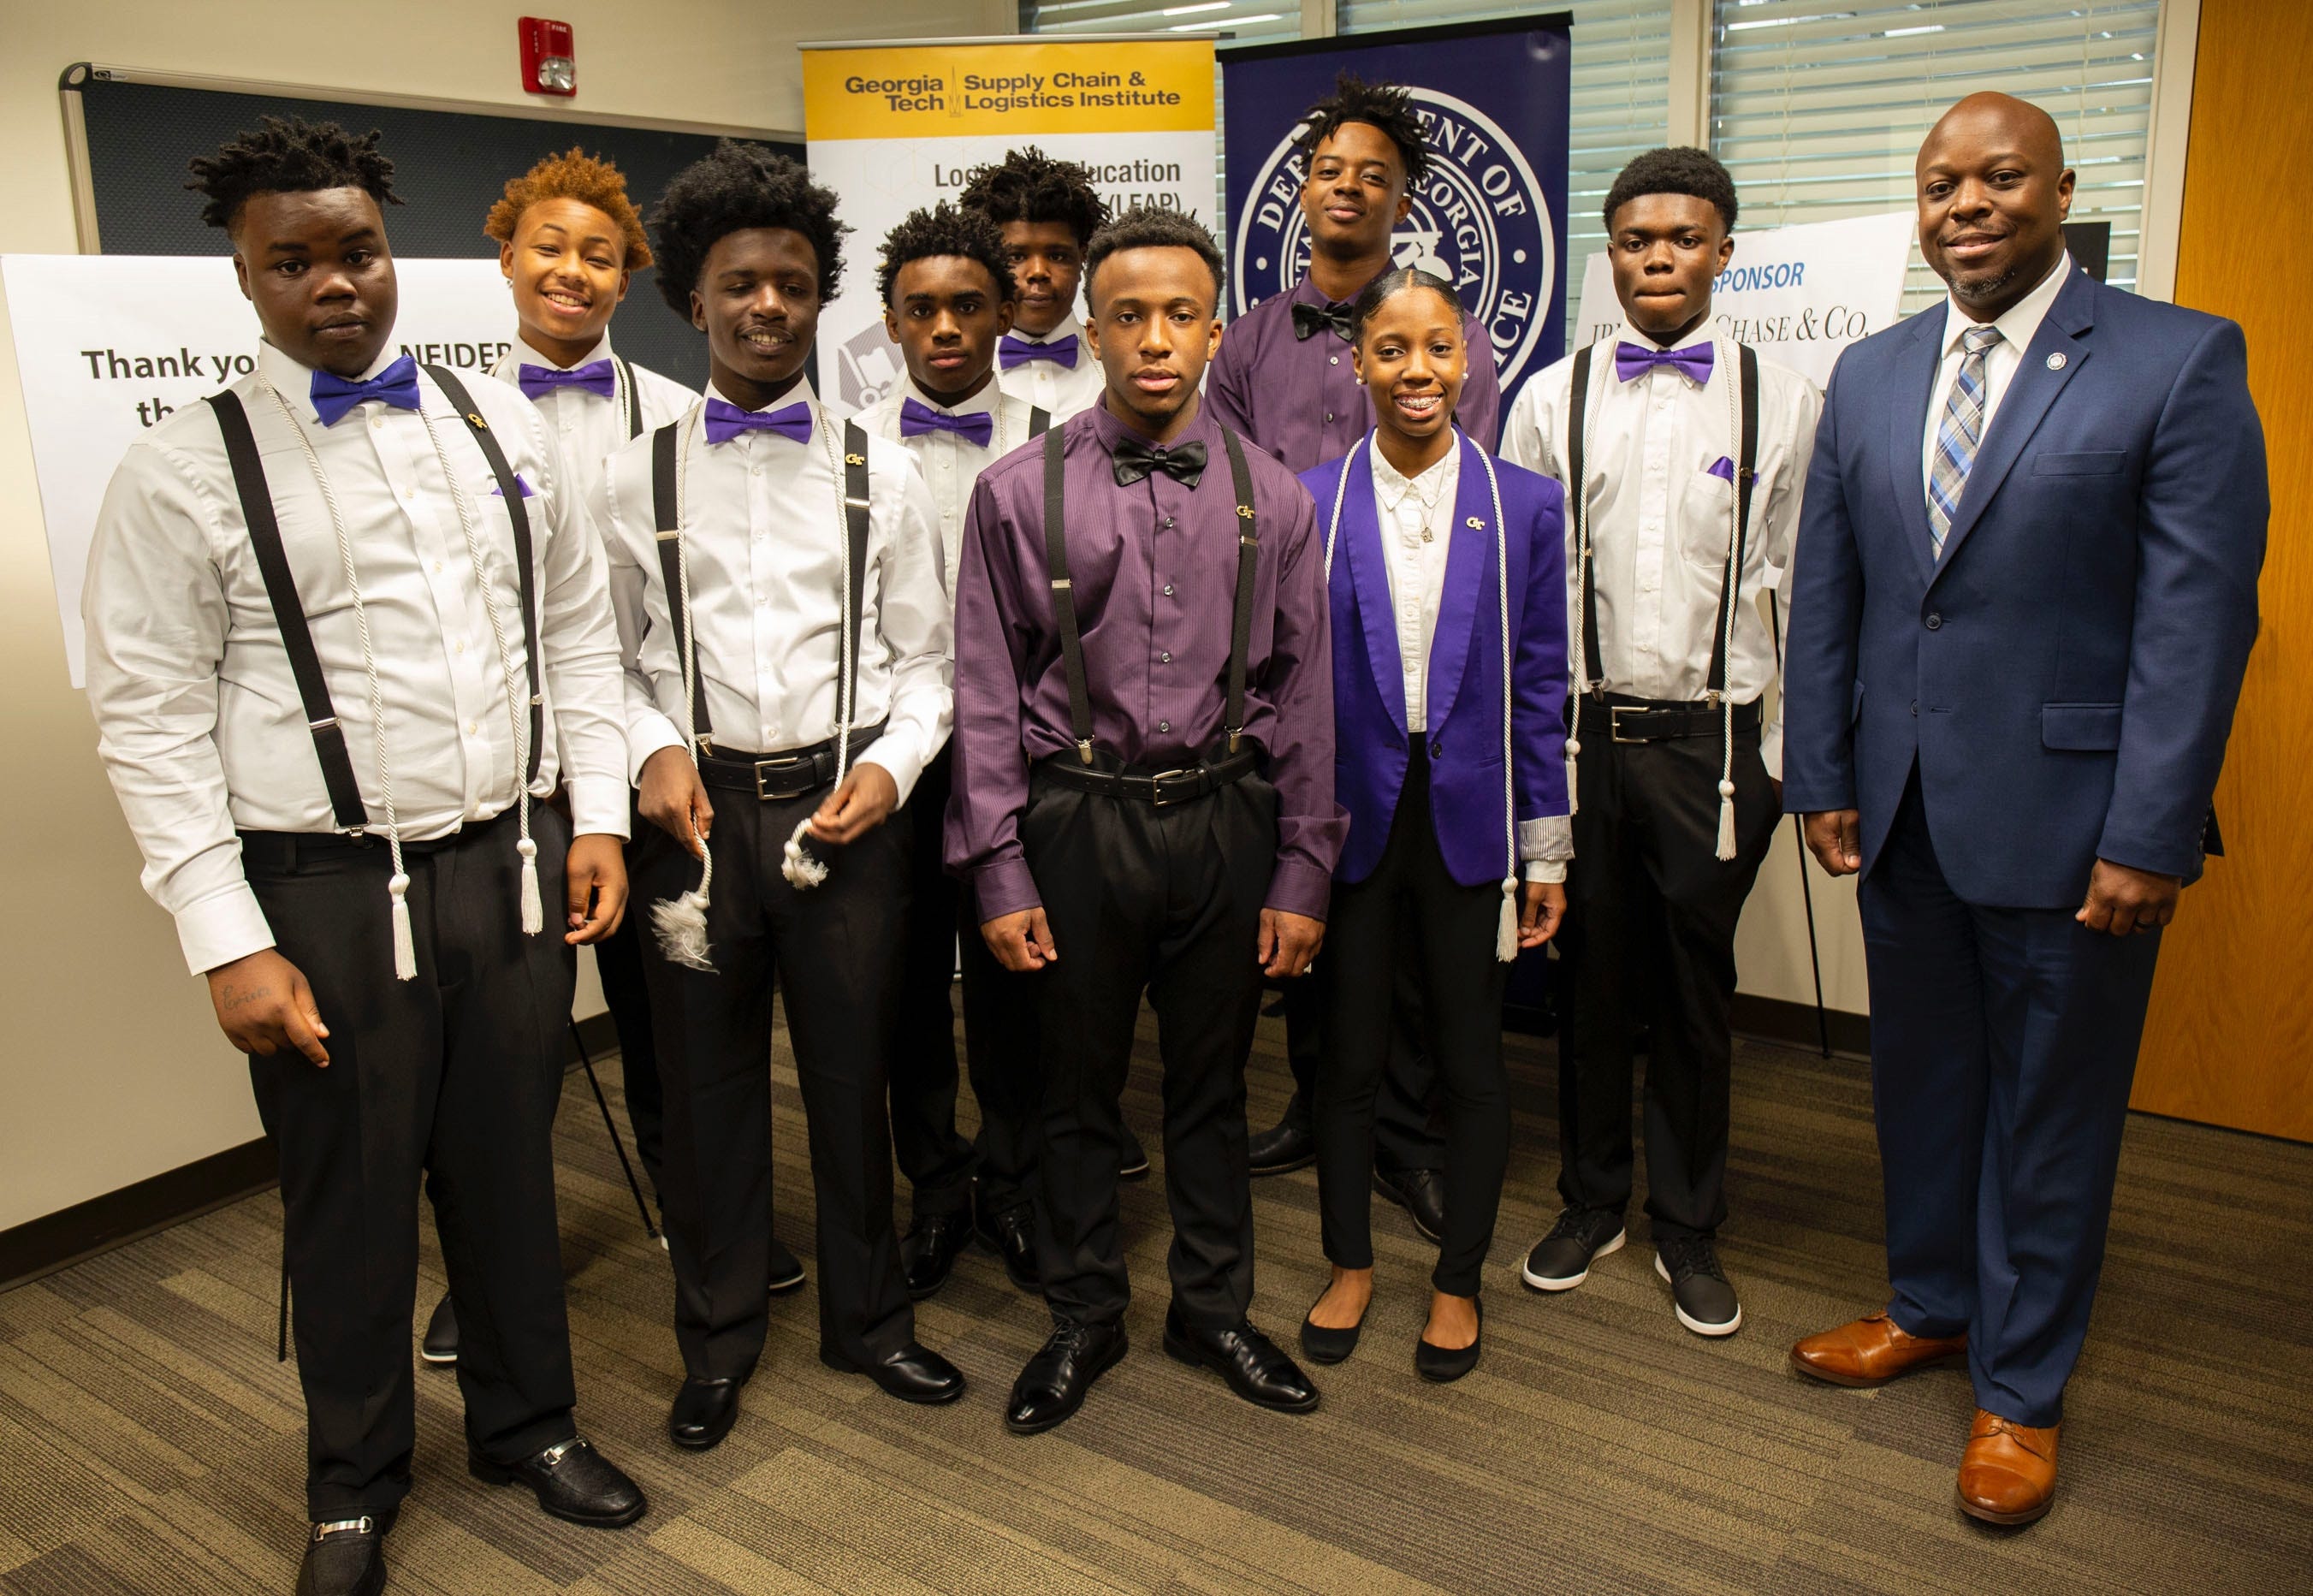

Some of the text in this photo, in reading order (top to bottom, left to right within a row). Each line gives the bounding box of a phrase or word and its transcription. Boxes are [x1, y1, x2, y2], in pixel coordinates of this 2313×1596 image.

[845, 74, 944, 96] Georgia
[964, 71, 1146, 92] Supply Chain &
[884, 93, 945, 112] Tech
[964, 90, 1181, 113] Logistics Institute
[1081, 158, 1181, 183] ucation
[1482, 164, 1527, 217] OF
[1797, 307, 1819, 341] &
[80, 347, 205, 379] Thank
[211, 353, 260, 384] yo
[136, 397, 175, 428] th
